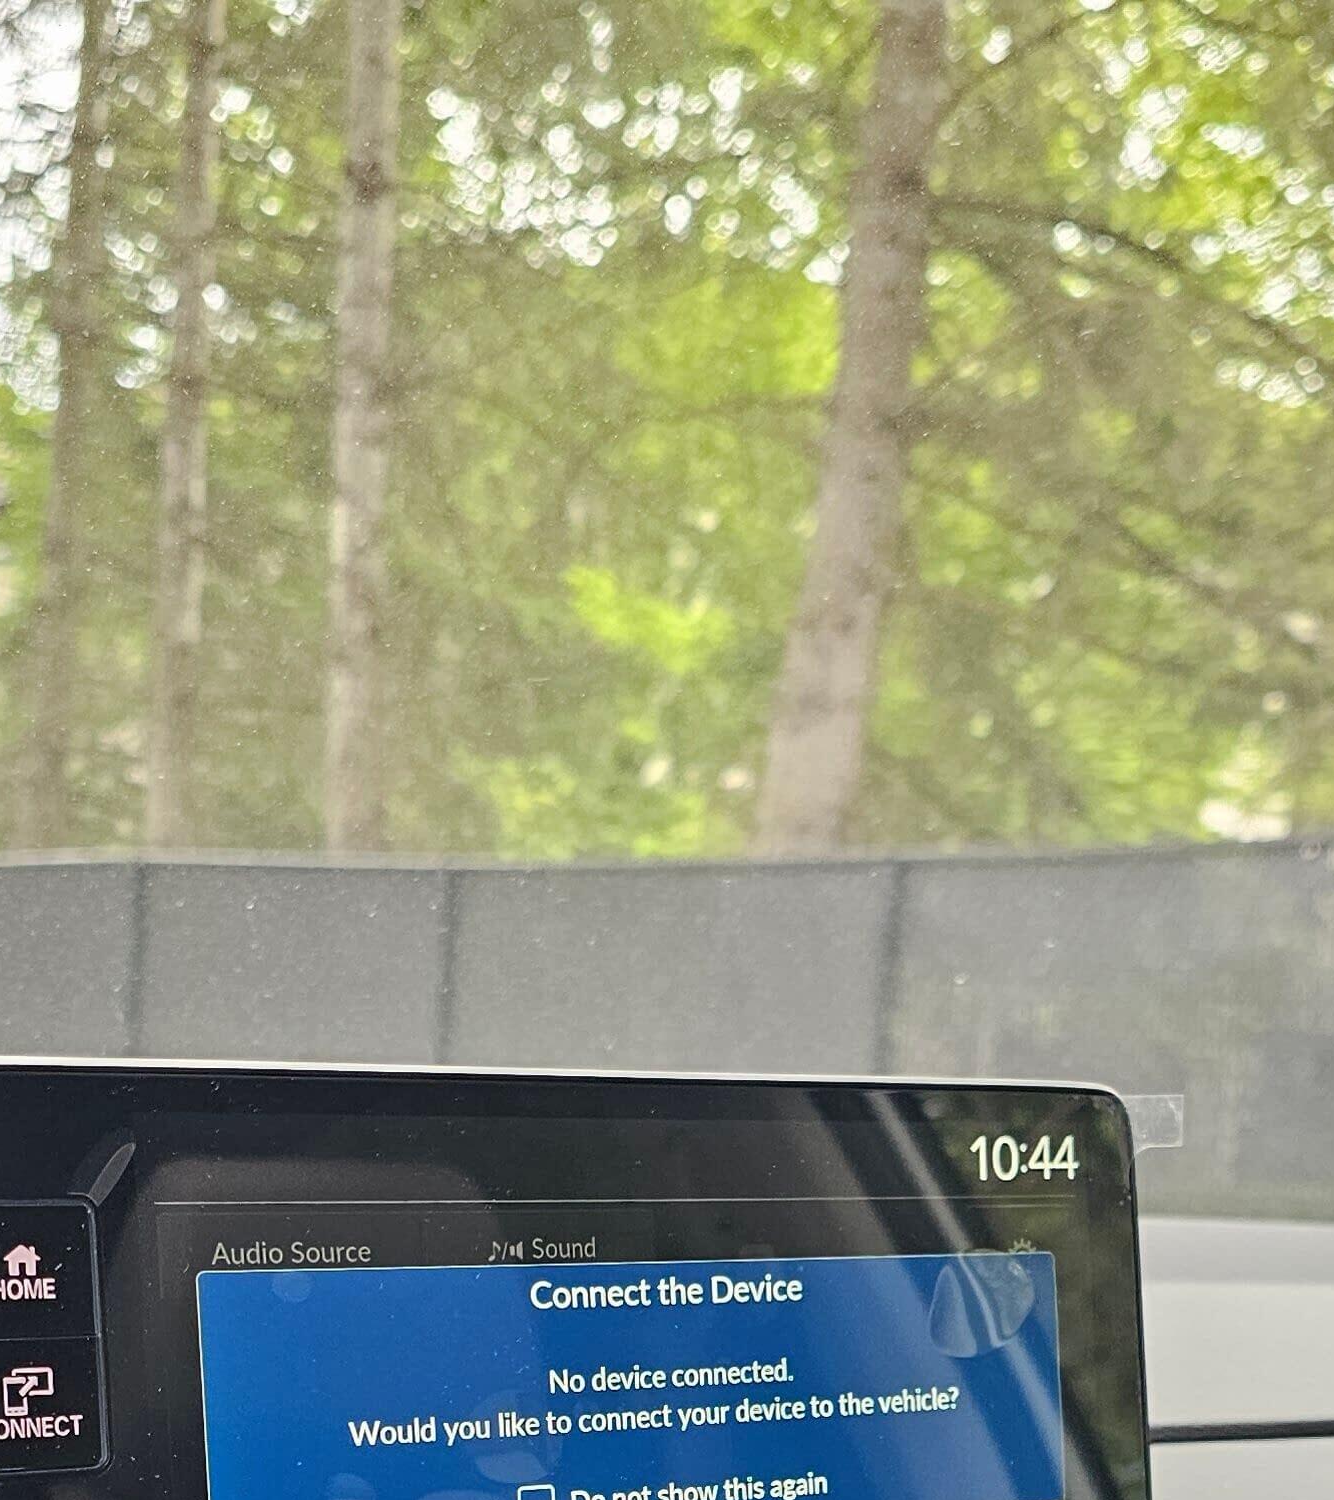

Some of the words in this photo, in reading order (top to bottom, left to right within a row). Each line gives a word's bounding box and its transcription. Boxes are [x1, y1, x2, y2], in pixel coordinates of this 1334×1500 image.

[970, 1135, 1079, 1181] 10:44
[212, 1242, 283, 1265] Audio
[291, 1241, 371, 1263] Source
[532, 1237, 596, 1259] Sound
[530, 1279, 650, 1309] Connect
[658, 1277, 703, 1305] the
[711, 1274, 802, 1304] Device
[549, 1369, 585, 1393] No
[591, 1365, 666, 1392] device
[672, 1358, 794, 1387] connected.
[348, 1417, 436, 1446] Would
[444, 1420, 490, 1446] you
[498, 1412, 540, 1437] like
[546, 1412, 572, 1435] to
[578, 1405, 673, 1432] connect
[679, 1402, 729, 1431] your
[736, 1396, 805, 1422] device
[810, 1396, 834, 1418] to
[838, 1391, 874, 1415] the
[878, 1386, 959, 1413] vehicle?
[769, 1472, 828, 1500] again
